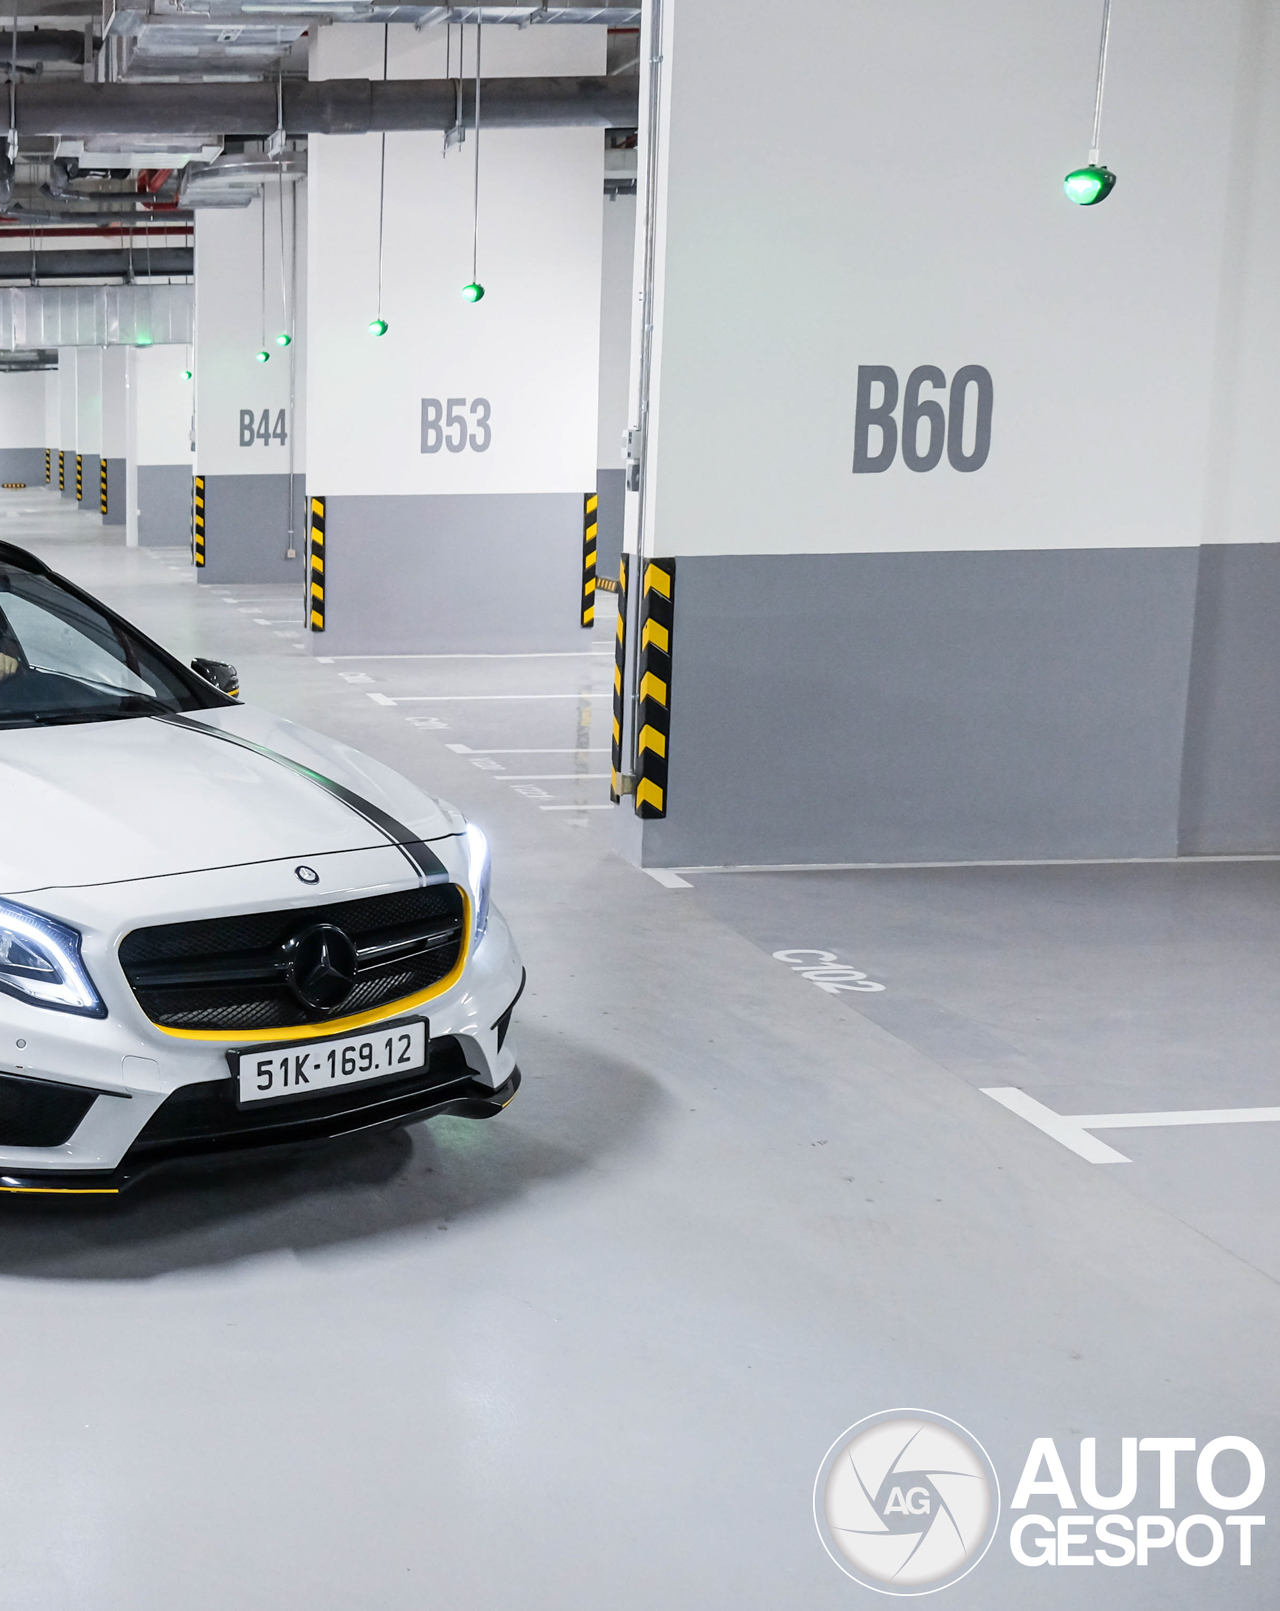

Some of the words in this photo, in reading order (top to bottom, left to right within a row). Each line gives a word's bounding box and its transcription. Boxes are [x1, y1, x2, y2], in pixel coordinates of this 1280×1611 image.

[239, 409, 288, 447] B44
[420, 397, 492, 455] B53
[852, 364, 994, 474] B60
[773, 949, 886, 994] C102
[256, 1034, 412, 1091] 51K-169.12
